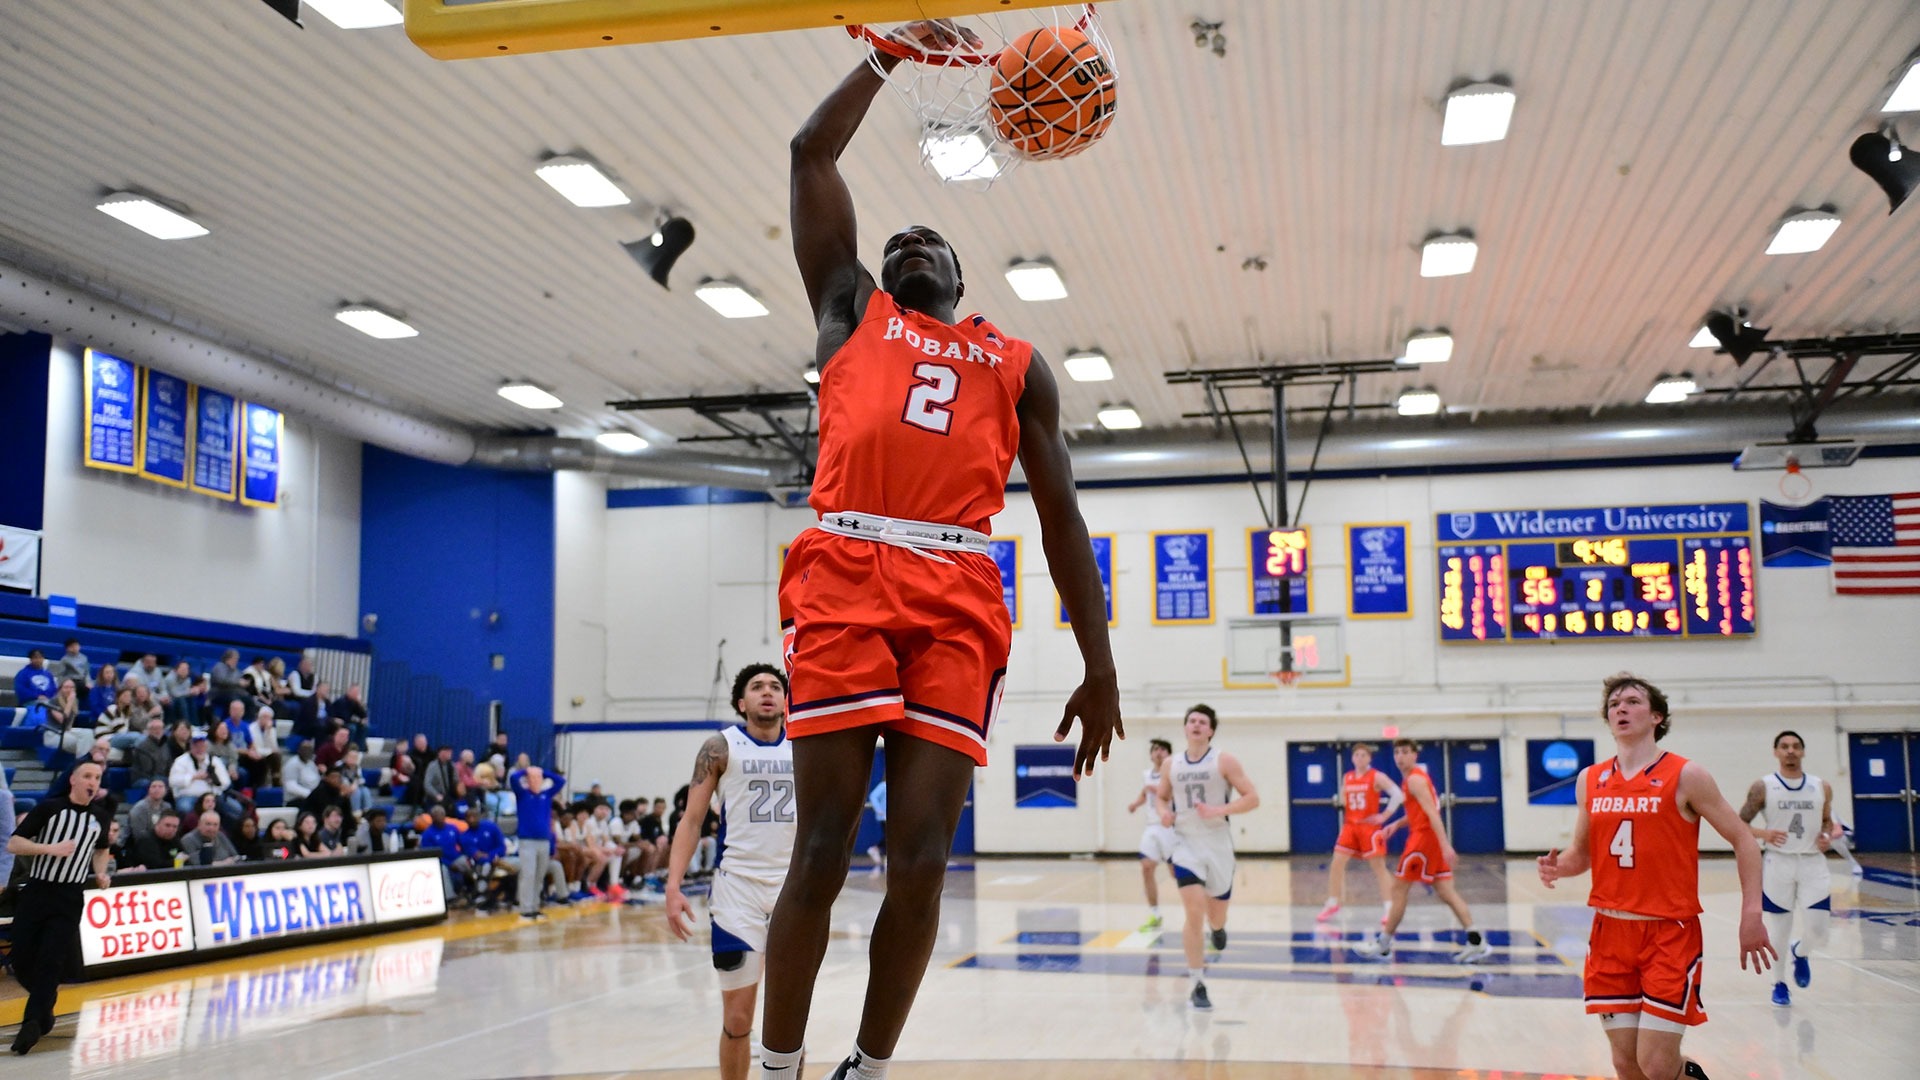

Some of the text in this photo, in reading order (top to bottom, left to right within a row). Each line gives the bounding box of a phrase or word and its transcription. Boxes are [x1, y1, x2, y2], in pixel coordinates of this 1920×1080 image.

[883, 316, 1003, 369] HOBART
[901, 361, 961, 436] 2
[1492, 505, 1731, 535] Widener University
[1266, 546, 1304, 577] 27
[1365, 565, 1393, 576] NCAA
[1523, 578, 1556, 606] 56
[1641, 574, 1674, 602] 35
[749, 779, 795, 823] 22
[1348, 792, 1366, 811] 55
[1591, 796, 1662, 814] HOBART
[1777, 800, 1814, 810] CAPTAINS
[1788, 812, 1806, 839] 4
[1608, 818, 1636, 869] 4
[86, 890, 182, 929] Office
[203, 880, 366, 943] WIDENER
[101, 927, 183, 959] DEPOT
